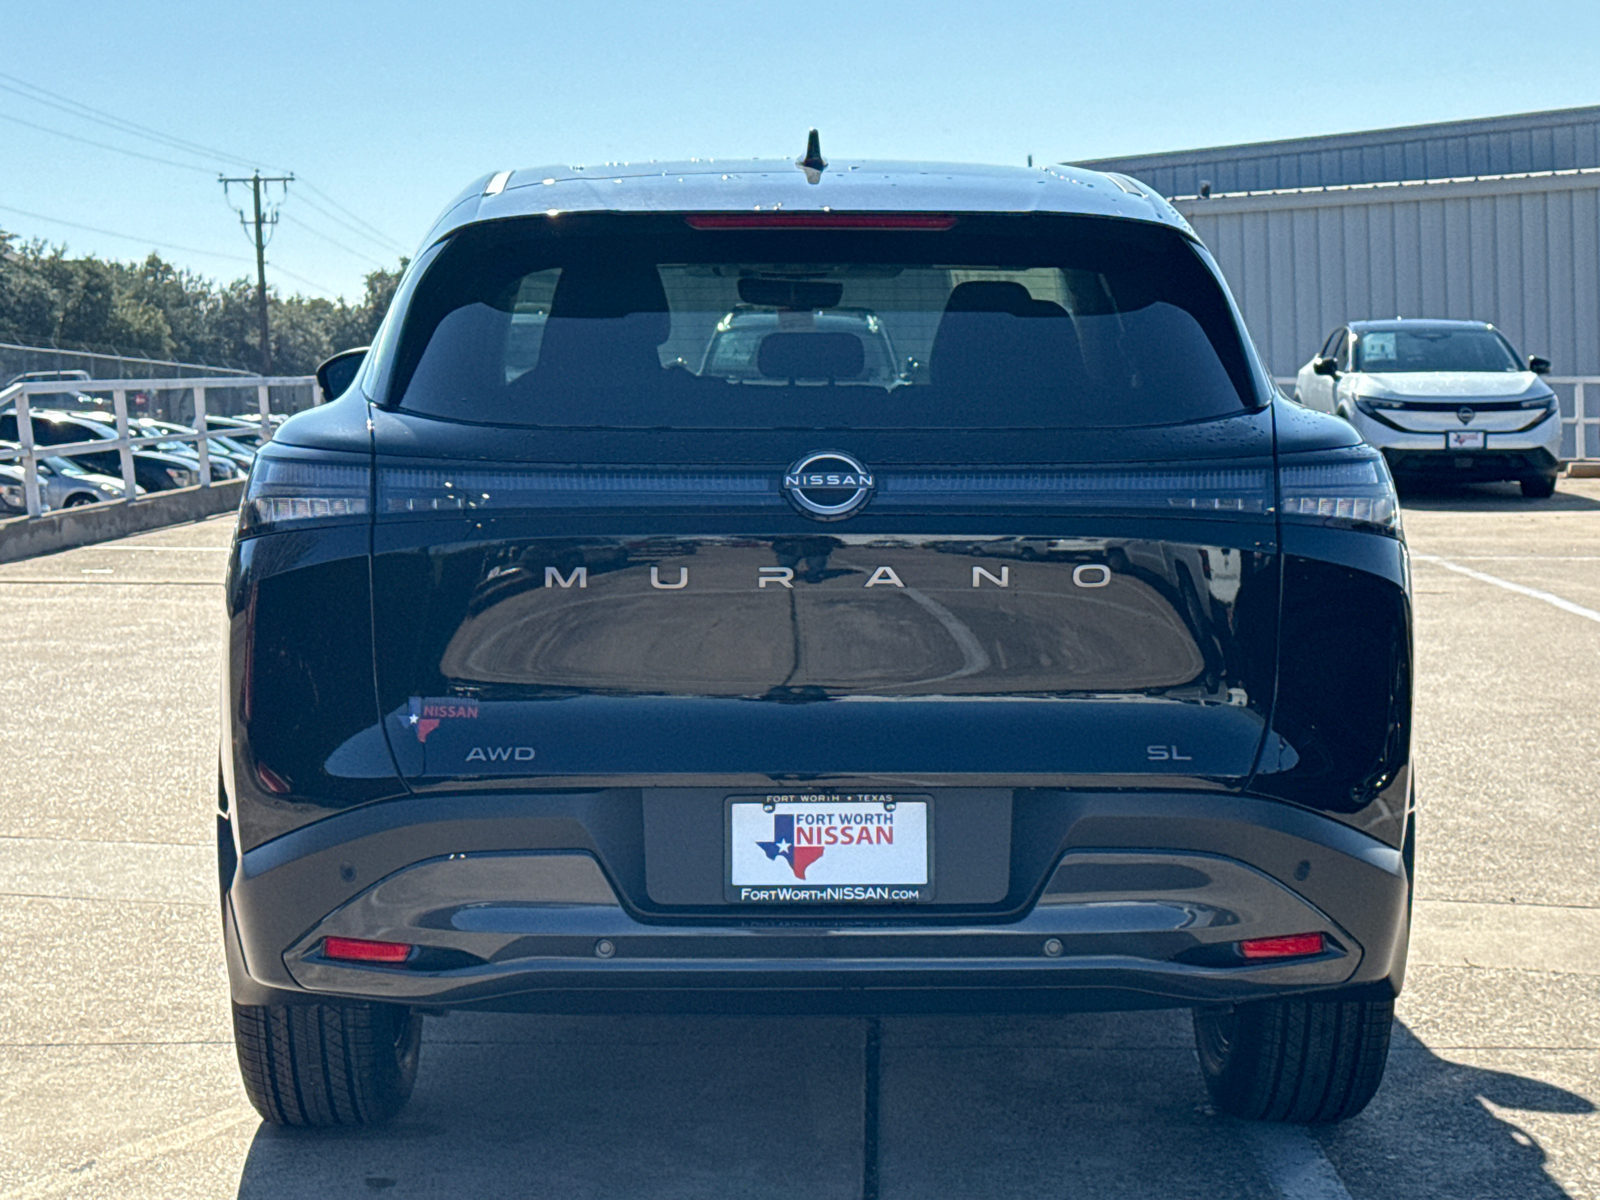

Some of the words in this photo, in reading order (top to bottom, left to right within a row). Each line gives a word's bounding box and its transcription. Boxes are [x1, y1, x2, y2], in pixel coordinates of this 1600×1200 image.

[785, 475, 873, 486] NISSAN
[544, 564, 1112, 589] MURANO
[423, 706, 479, 719] NISSAN
[465, 747, 536, 762] AWD
[1146, 744, 1193, 760] SL
[857, 794, 893, 802] TEXAS
[796, 813, 835, 825] FORT
[839, 813, 893, 825] WORTH
[796, 826, 894, 845] NISSAN
